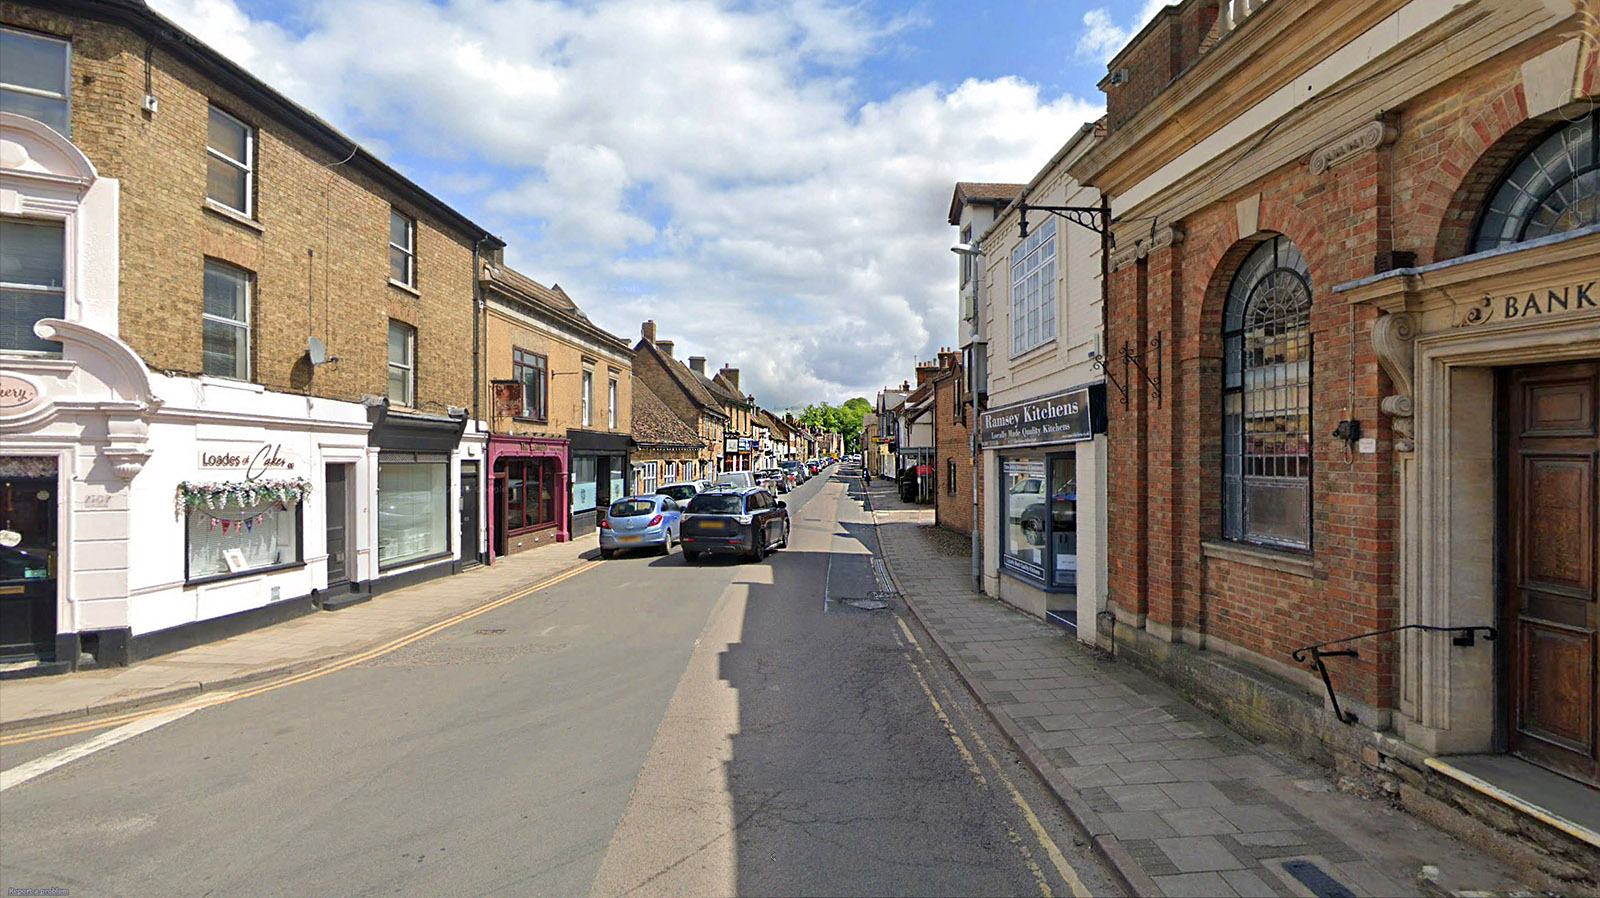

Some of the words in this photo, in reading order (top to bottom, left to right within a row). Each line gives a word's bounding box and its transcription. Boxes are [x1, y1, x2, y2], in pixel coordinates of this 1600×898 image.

[1505, 281, 1597, 318] BANK
[985, 414, 1020, 429] Ramsey
[1024, 401, 1079, 422] Kitchens
[1022, 426, 1041, 437] Quality
[1042, 423, 1070, 433] Kitchens
[202, 452, 241, 467] Loades
[246, 443, 286, 480] Cakes
